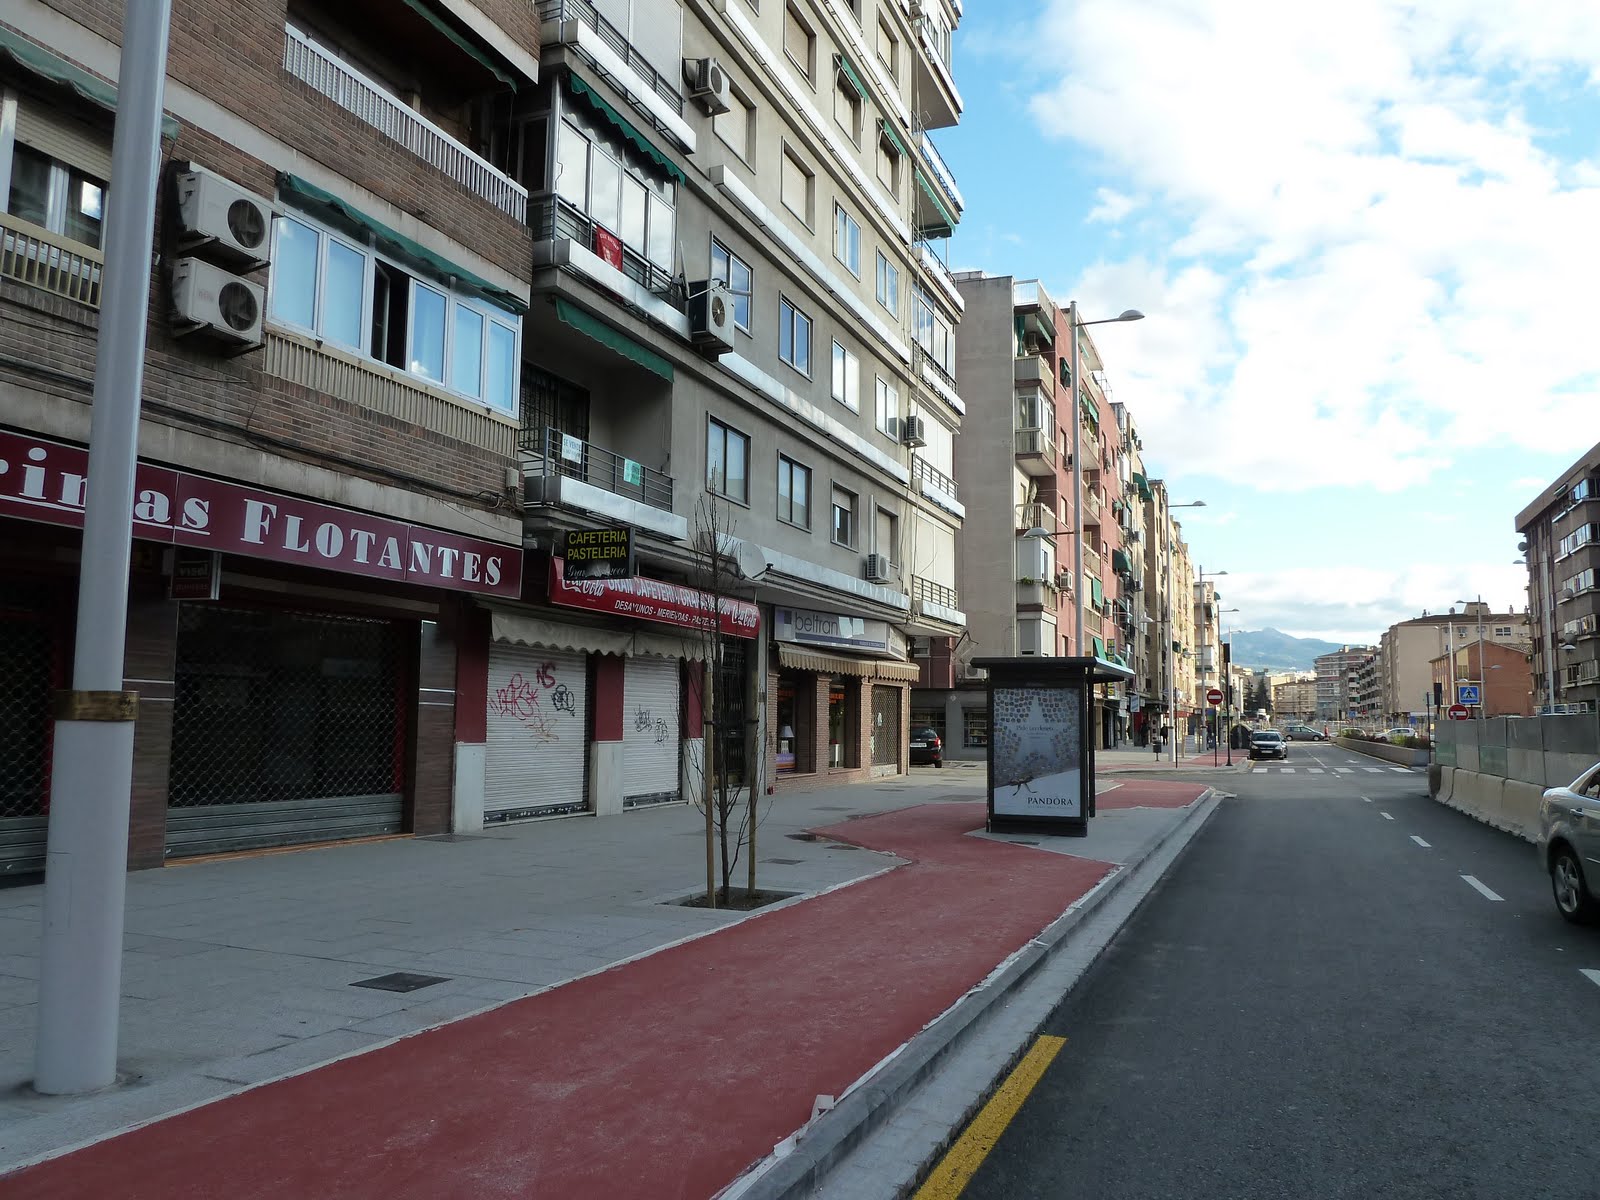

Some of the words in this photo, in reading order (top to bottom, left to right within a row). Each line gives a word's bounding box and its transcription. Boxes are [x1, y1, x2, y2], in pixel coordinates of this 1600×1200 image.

[240, 498, 502, 586] FLOTANTES
[568, 530, 627, 545] CAFETERIA
[567, 546, 627, 560] PASTELERIA
[614, 599, 654, 615] DESAYUNOS
[795, 611, 839, 635] beltran
[1107, 639, 1115, 696] MUEES
[1027, 796, 1073, 806] PANDORA
